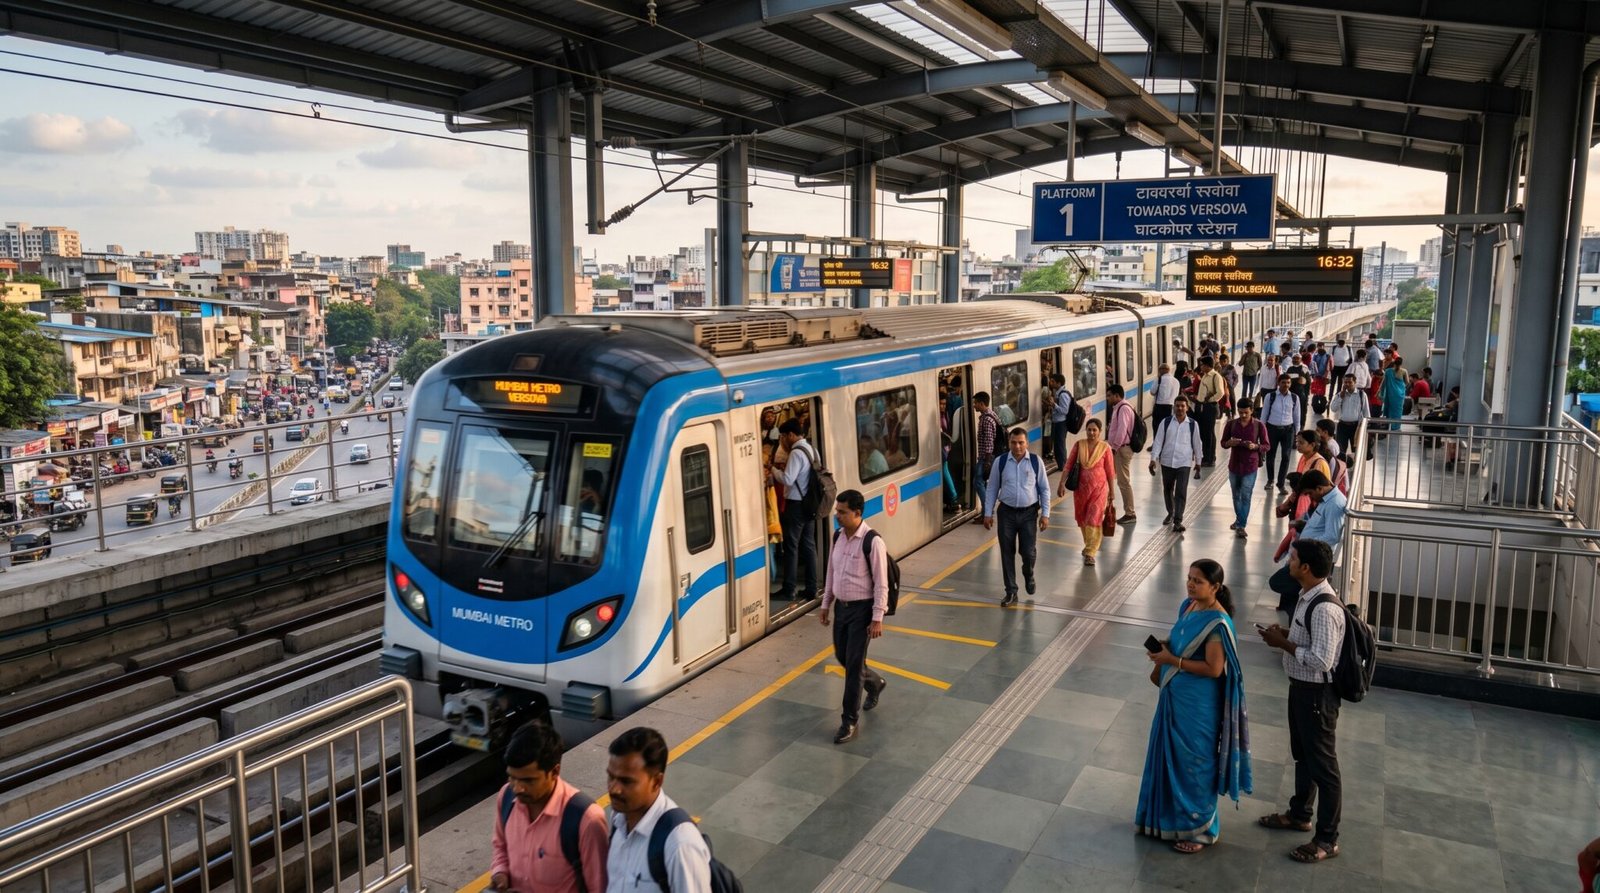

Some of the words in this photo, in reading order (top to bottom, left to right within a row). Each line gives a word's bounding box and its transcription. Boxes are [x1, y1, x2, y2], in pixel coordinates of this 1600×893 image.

[1041, 187, 1095, 199] PLATFORM
[1127, 204, 1187, 217] TOWARDS
[1190, 203, 1248, 215] VERSOVA
[1059, 203, 1074, 237] 1
[1134, 219, 1194, 236] घाटकोपर
[1196, 218, 1238, 235] स्टेशन
[871, 261, 889, 270] 16:32
[1317, 255, 1354, 268] 16:32
[495, 380, 529, 392] MUMBAI
[530, 382, 561, 394] METRO
[508, 392, 547, 404] VERSOVA
[740, 444, 753, 458] 112
[452, 607, 492, 624] MUMBAI
[494, 615, 534, 632] METRO
[747, 614, 760, 628] 112
